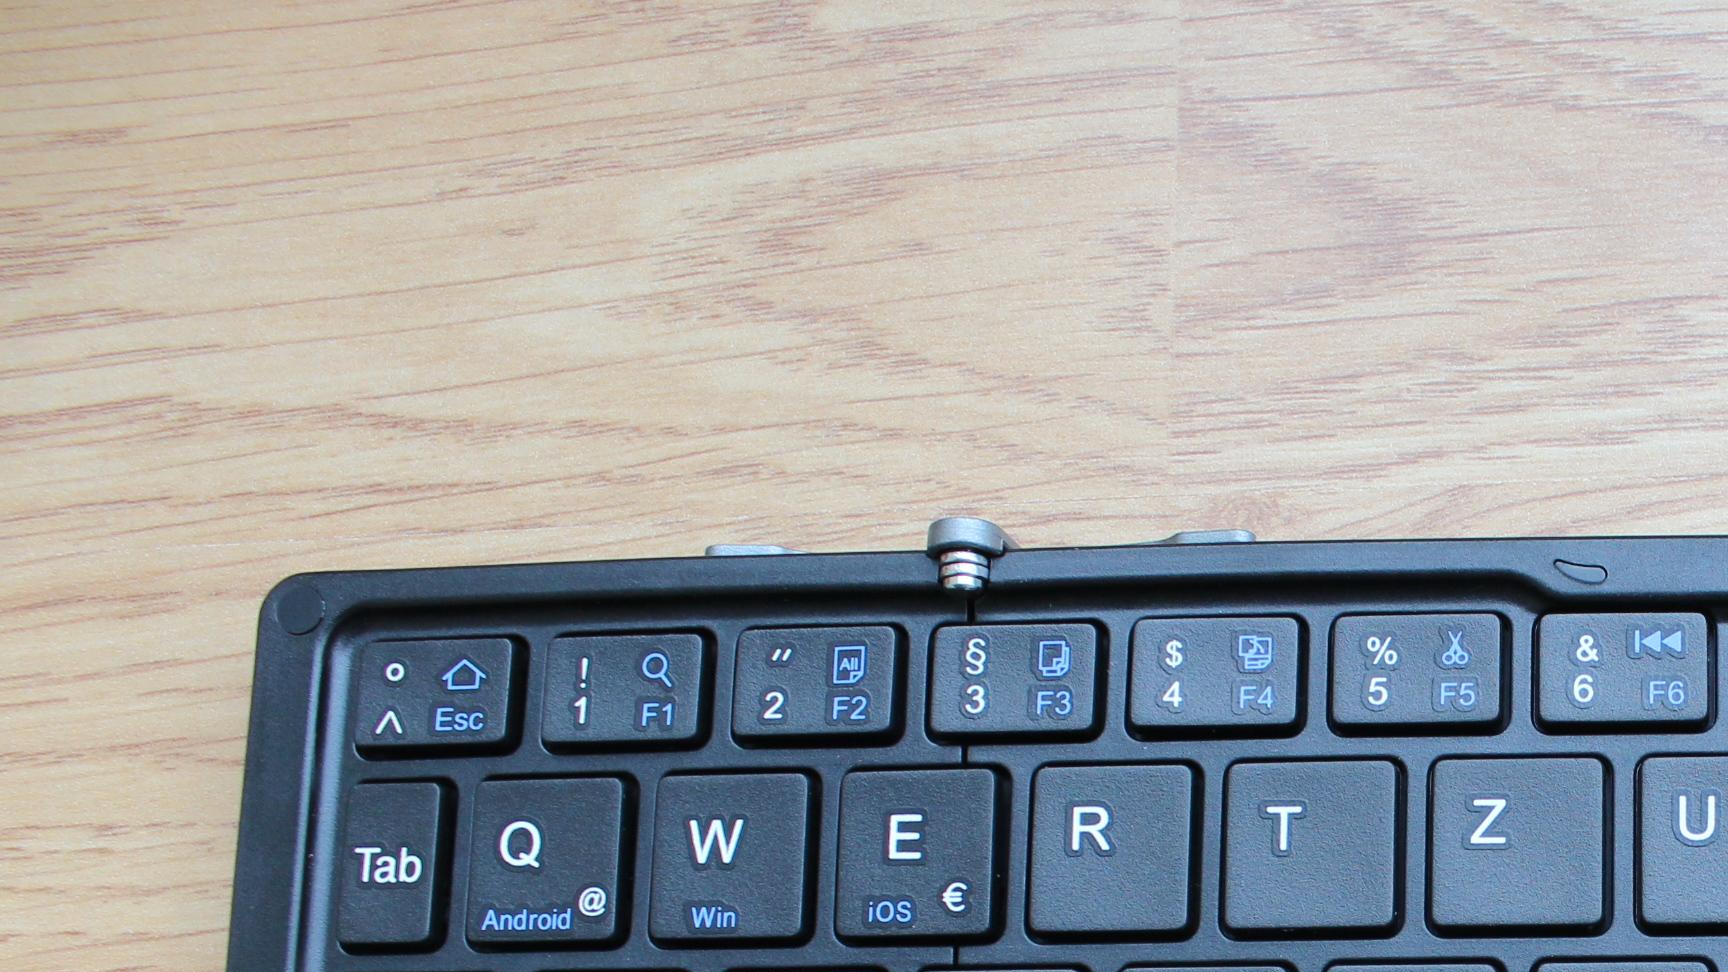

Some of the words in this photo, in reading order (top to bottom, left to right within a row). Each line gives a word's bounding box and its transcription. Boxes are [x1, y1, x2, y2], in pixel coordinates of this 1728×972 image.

[839, 657, 859, 671] All
[965, 684, 986, 714] 3
[1162, 680, 1183, 708] 4
[1239, 685, 1274, 709] F4
[1367, 677, 1389, 706] 5
[1440, 682, 1476, 706] F5
[1573, 674, 1594, 703] 6
[1649, 680, 1685, 705] F6
[574, 696, 587, 724] 1
[641, 702, 672, 727] F1
[763, 691, 784, 719] 2
[832, 695, 867, 720] F2
[1036, 690, 1071, 716] F3
[434, 707, 484, 731] Esc
[1071, 806, 1110, 851] R
[1266, 805, 1303, 851] T
[1470, 798, 1507, 844] Z
[1678, 795, 1716, 841] U
[499, 821, 541, 868] Q
[689, 819, 744, 864] W
[888, 813, 923, 860] E
[354, 846, 422, 884] Tab
[481, 907, 572, 931] Android
[691, 906, 736, 929] Win
[868, 900, 912, 923] iOS
